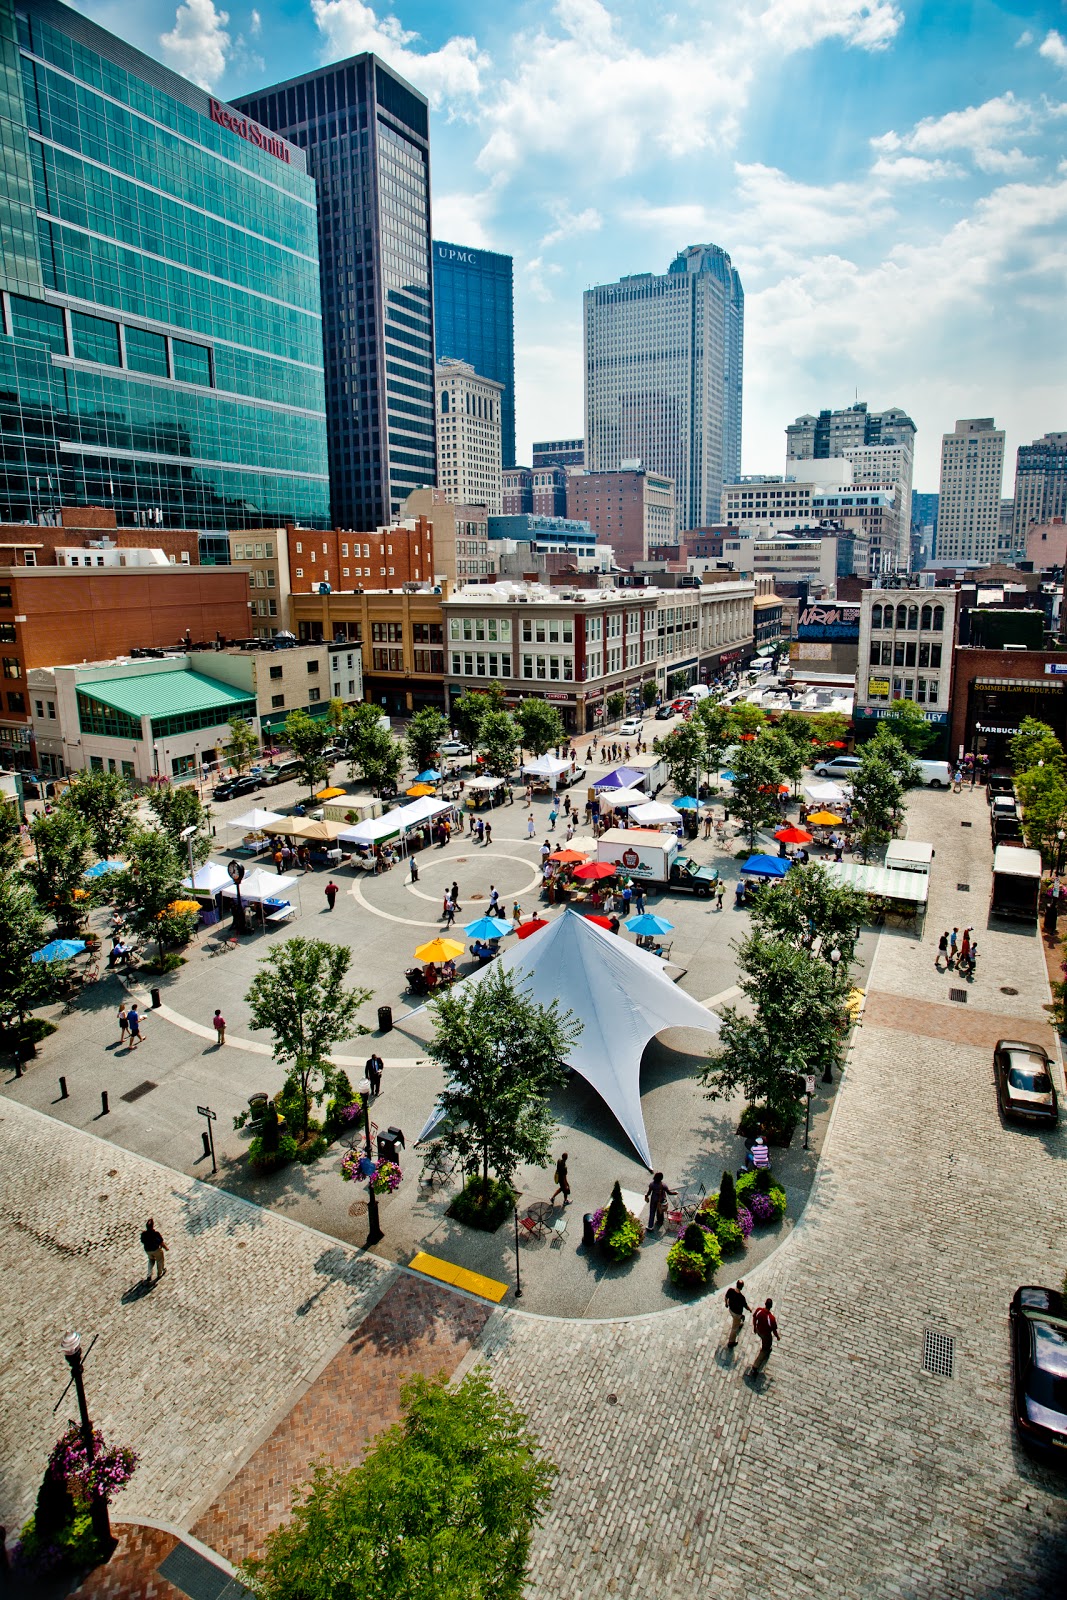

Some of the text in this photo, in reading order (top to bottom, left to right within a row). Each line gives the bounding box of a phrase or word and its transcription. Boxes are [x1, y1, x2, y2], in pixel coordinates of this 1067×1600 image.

[210, 98, 290, 164] Reed Smith
[438, 247, 477, 265] UPMC
[974, 683, 1006, 692] SOMMER
[977, 726, 1023, 735] TARBUCKS
